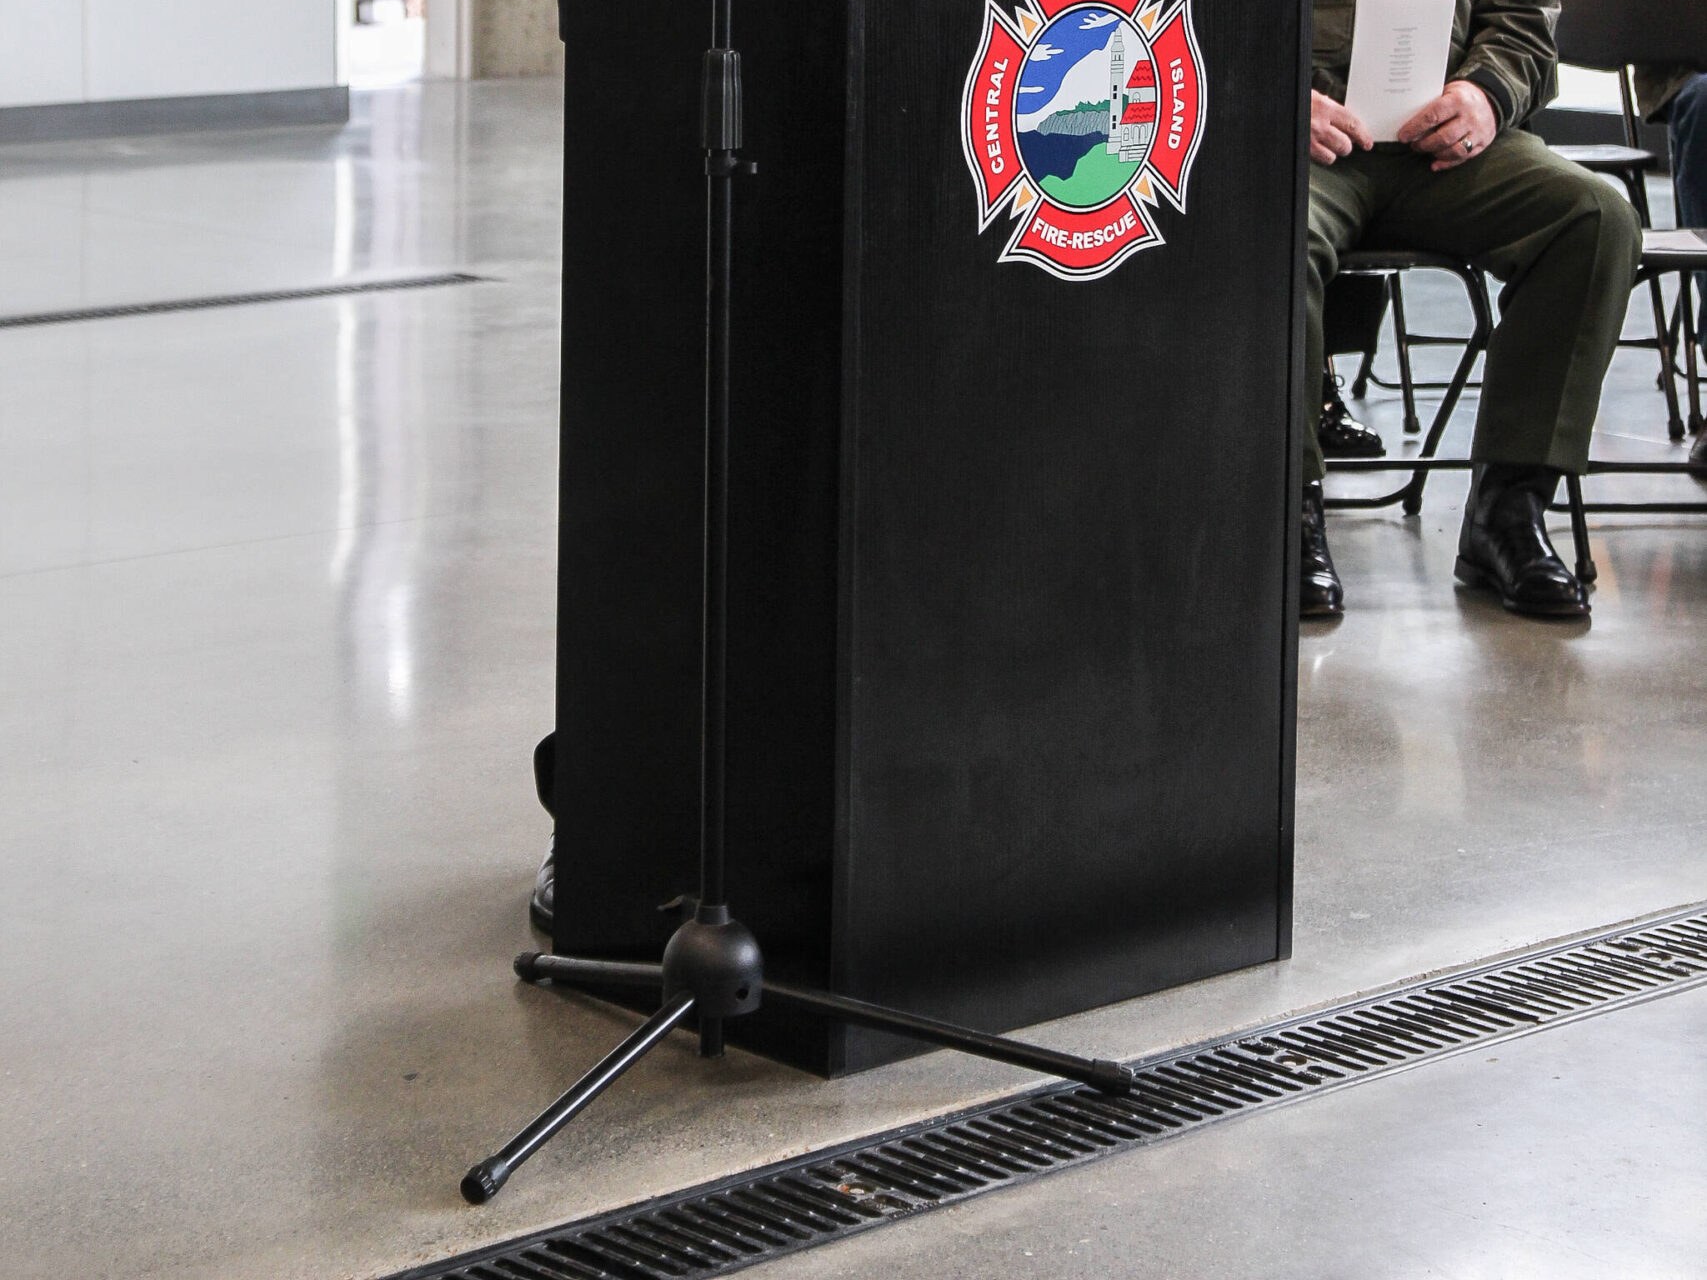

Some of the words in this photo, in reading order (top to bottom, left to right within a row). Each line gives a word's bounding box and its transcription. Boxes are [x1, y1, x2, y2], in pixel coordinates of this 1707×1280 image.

[985, 57, 1010, 174] CENTRAL
[1168, 58, 1185, 150] ISLAND
[1031, 210, 1137, 250] FIRE-RESCUE
